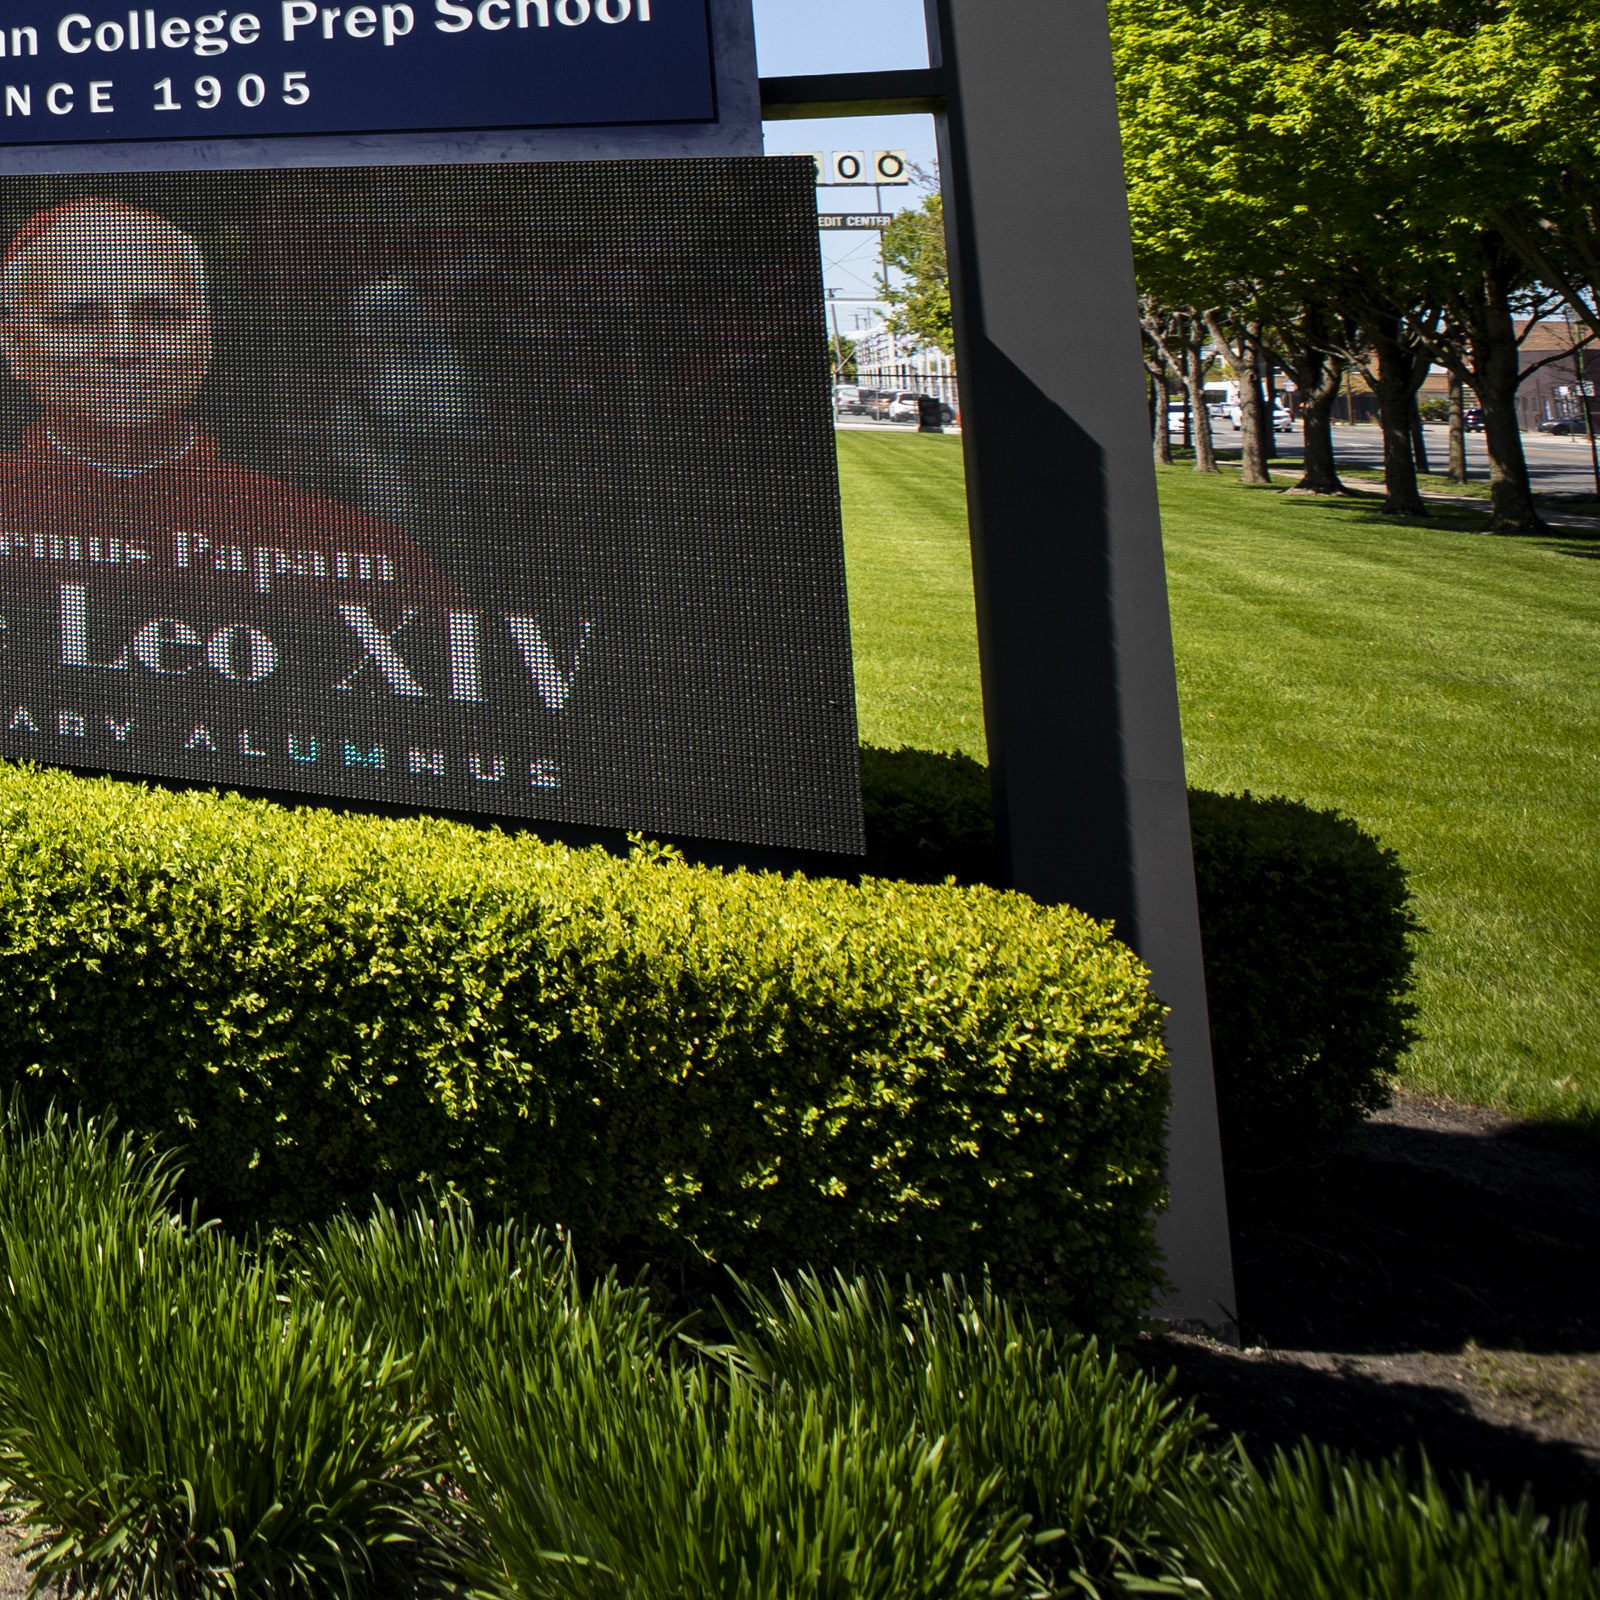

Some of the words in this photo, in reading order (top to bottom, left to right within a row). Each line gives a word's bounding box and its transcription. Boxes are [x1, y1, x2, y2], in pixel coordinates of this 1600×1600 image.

[57, 8, 261, 56] College
[281, 0, 415, 46] Prep
[152, 71, 311, 112] 1905
[846, 215, 891, 227] CENTER
[173, 530, 395, 593] Papam
[57, 580, 279, 682] Leo
[332, 601, 597, 710] XIV
[184, 723, 562, 788] ALUMNUS
